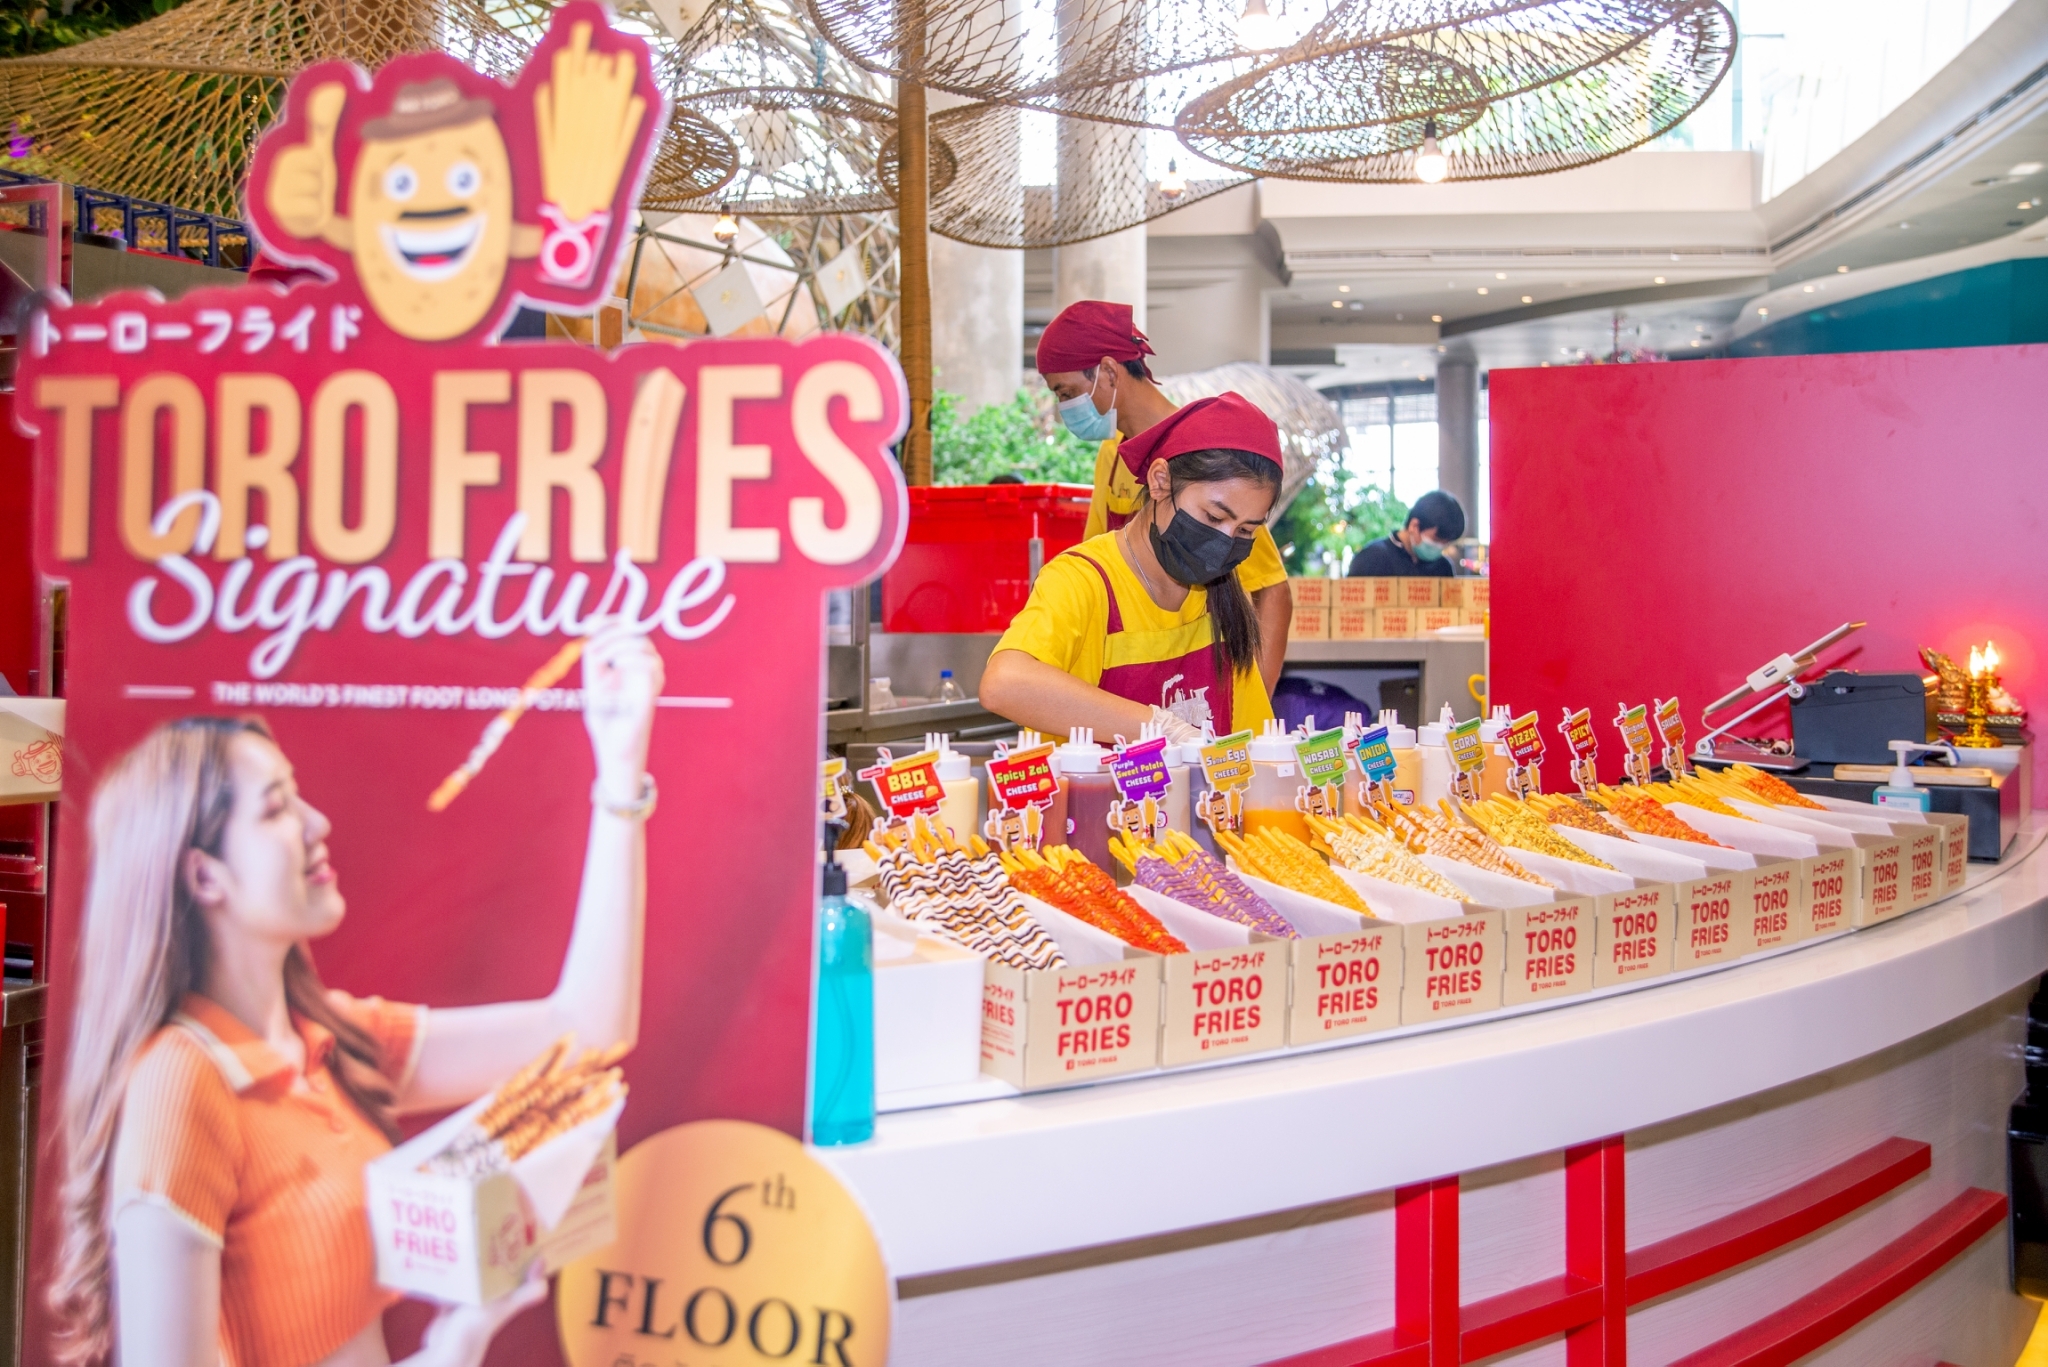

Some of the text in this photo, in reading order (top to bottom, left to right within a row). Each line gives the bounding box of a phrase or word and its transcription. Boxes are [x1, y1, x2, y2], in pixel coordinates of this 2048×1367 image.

[33, 305, 362, 356] トーローフライド
[33, 362, 886, 567] TORO FRIES
[128, 490, 737, 680] Signature
[213, 682, 250, 702] THE
[251, 683, 339, 705] WORLD'S
[342, 685, 407, 707] FINEST
[410, 686, 462, 709] FOOT
[465, 687, 520, 710] LONG
[1452, 733, 1478, 752] CORN
[1507, 727, 1537, 749] PIZZA
[1569, 723, 1590, 742] SPICY
[1226, 748, 1247, 763] Egg
[1303, 746, 1339, 765] WASABI
[1359, 742, 1388, 761] ONION
[995, 763, 1049, 785] Spicy Zab
[1113, 760, 1134, 770] Purple
[1116, 761, 1164, 779] Sweet Potato
[1213, 767, 1239, 779] CHEESE
[1309, 763, 1334, 775] CHEESE
[1367, 760, 1385, 770] CHEESE
[887, 769, 928, 792] BBQ
[1006, 783, 1038, 796] CHEESE
[1125, 775, 1153, 787] CHEESE
[890, 790, 925, 804] CHEESE
[1873, 861, 1898, 885] TORO
[1912, 850, 1933, 873] TORO
[1812, 875, 1843, 900] TORO
[1872, 883, 1898, 905] FRIES
[1911, 871, 1932, 892] FRIES
[1690, 898, 1730, 924] TORO
[1753, 888, 1789, 914] TORO
[1811, 898, 1842, 922] FRIES
[1526, 906, 1579, 926] トーローフライド
[1612, 911, 1658, 938] TORO
[1753, 912, 1787, 936] FRIES
[1427, 920, 1486, 942] トーローフライド
[1524, 926, 1577, 954] TORO
[1690, 922, 1729, 948] FRIES
[1318, 935, 1382, 959] トーローフライド
[1425, 941, 1483, 971] TORO
[1613, 937, 1656, 963] FRIES
[1193, 951, 1265, 976] トーローフライド
[1316, 956, 1380, 989] TORO
[1525, 953, 1575, 980] FRIES
[1058, 968, 1136, 993] トーローフライド
[1192, 974, 1263, 1008] TORO
[1426, 969, 1482, 998] FRIES
[982, 998, 1014, 1026] RIES
[1056, 991, 1134, 1026] TORO
[1317, 986, 1378, 1018] FRIES
[1193, 1004, 1261, 1037] FRIES
[1057, 1023, 1131, 1057] FRIES
[390, 1198, 458, 1235] TORO
[392, 1228, 459, 1264] FRIES
[588, 1267, 857, 1367] FLOOR
